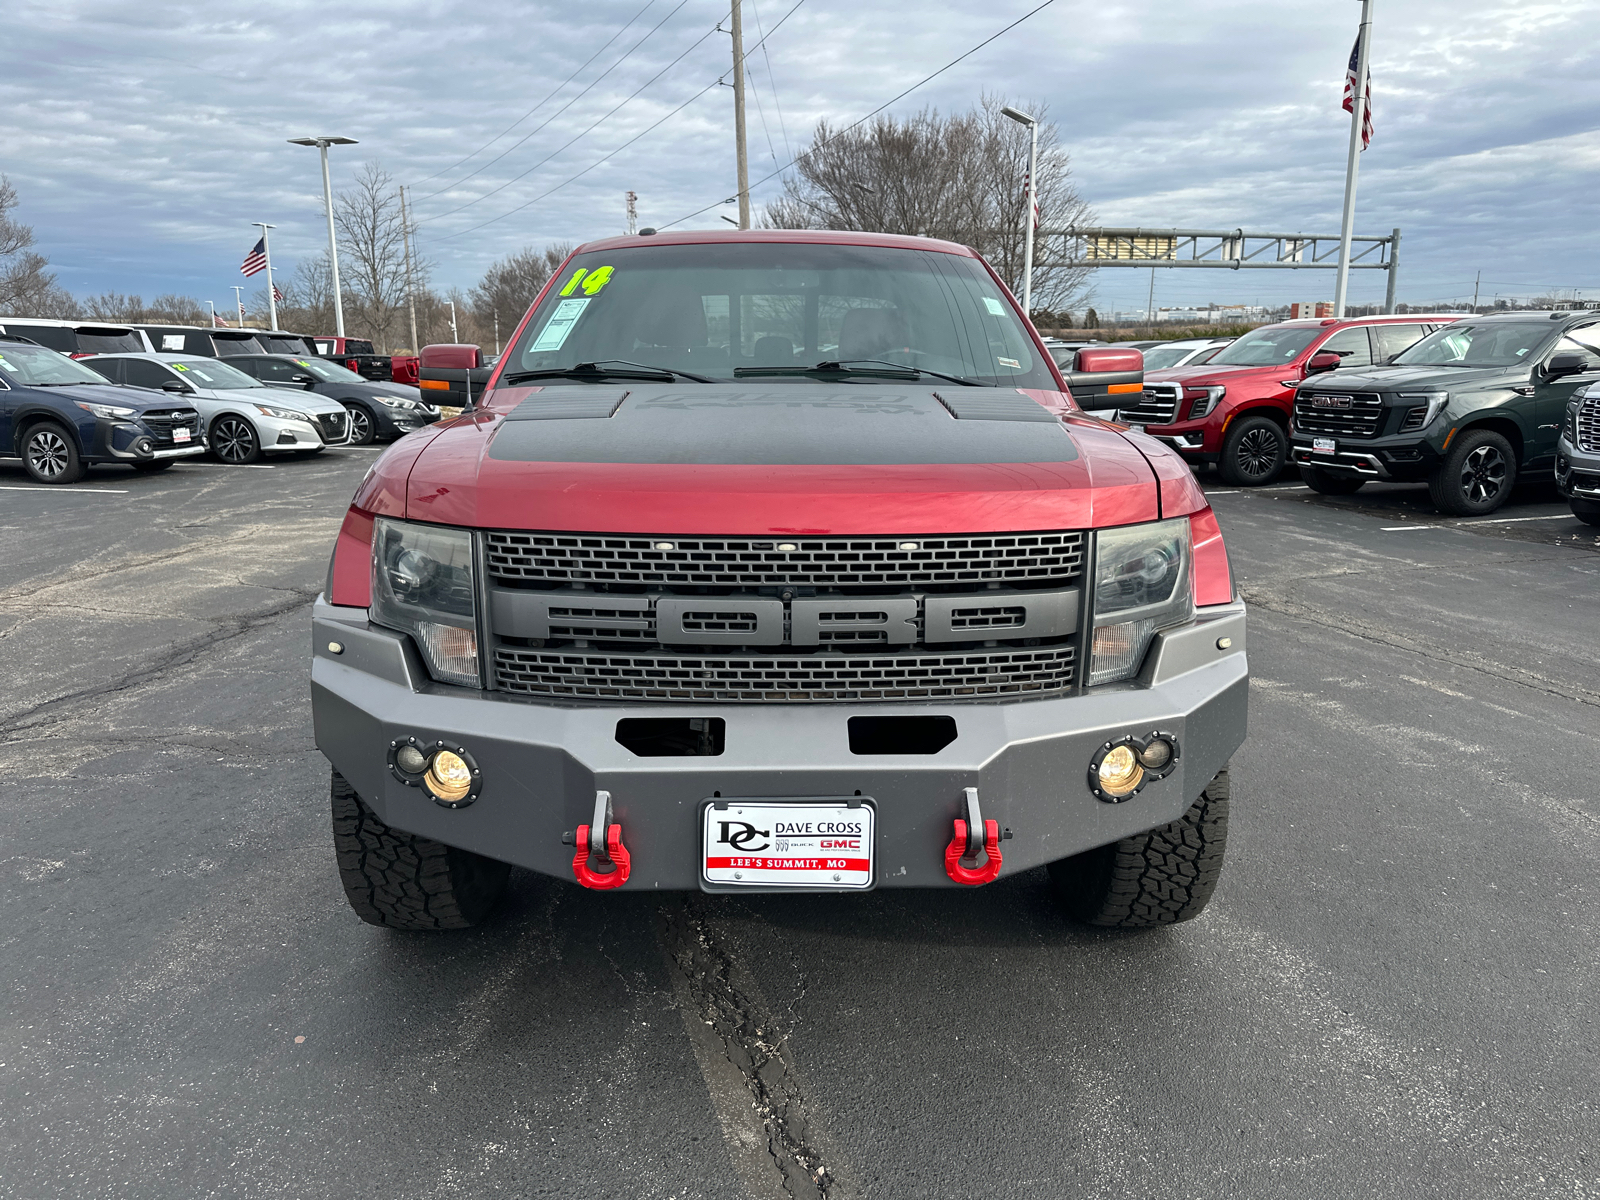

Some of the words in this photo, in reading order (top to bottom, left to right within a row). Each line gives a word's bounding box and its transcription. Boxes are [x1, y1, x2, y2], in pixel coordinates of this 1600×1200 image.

[559, 265, 615, 296] 14
[1312, 396, 1350, 408] GMC
[491, 588, 1079, 646] FORD
[775, 822, 813, 833] DAVE
[817, 822, 862, 834] CROSS
[820, 839, 861, 849] GMC
[730, 858, 763, 867] LEE'S
[766, 859, 822, 870] SUMMIT,
[826, 859, 847, 868] MO
